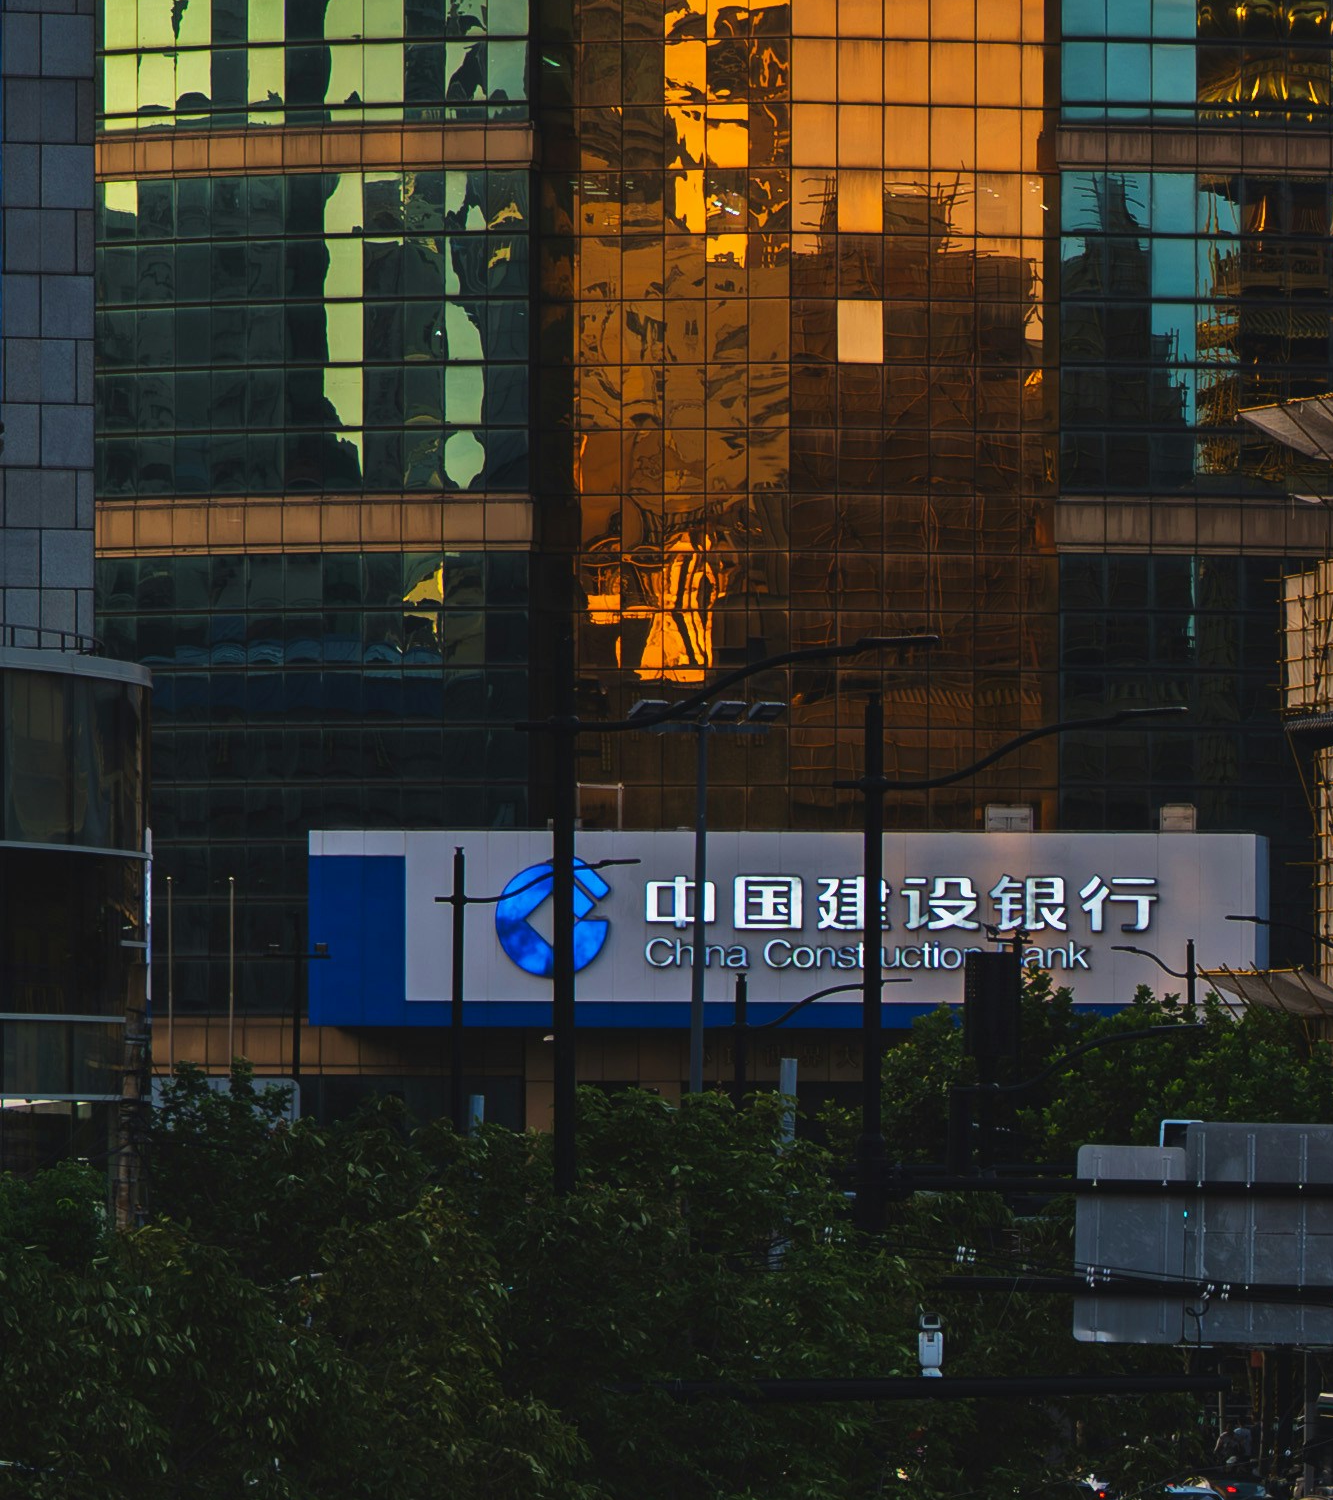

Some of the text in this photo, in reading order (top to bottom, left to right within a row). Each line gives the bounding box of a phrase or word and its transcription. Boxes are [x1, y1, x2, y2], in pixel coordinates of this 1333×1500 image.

[645, 875, 1158, 932] 中国建设银行
[645, 939, 1091, 970] Chna Constuctio ank
